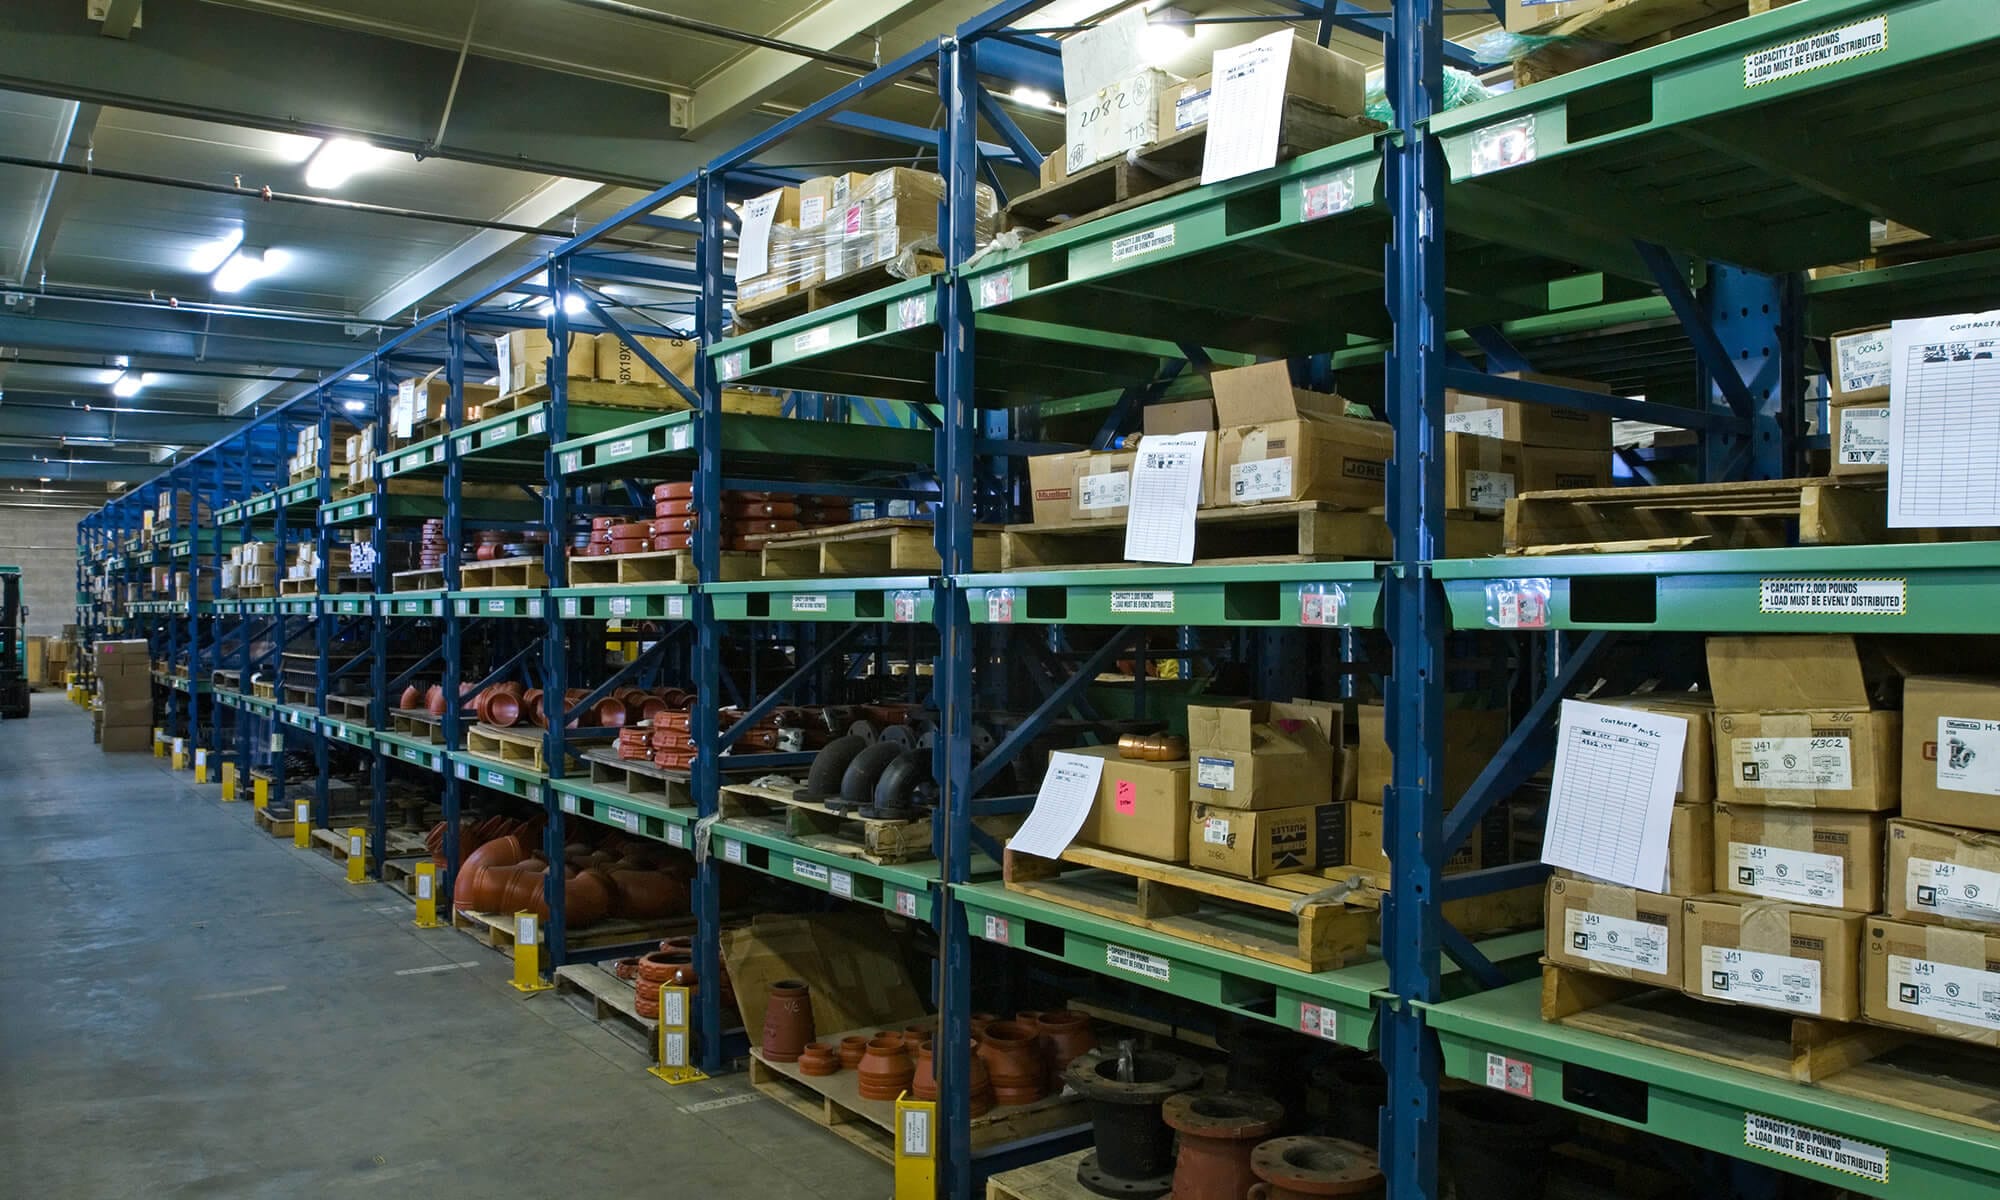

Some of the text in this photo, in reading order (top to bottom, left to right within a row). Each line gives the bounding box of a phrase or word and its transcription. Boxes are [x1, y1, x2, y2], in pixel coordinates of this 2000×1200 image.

[1754, 48, 1788, 66] CAPACITY
[1811, 32, 1840, 48] POUNDS
[1754, 33, 1882, 78] LOAD MUST BE EVENLY DISTRIBUTED
[1081, 92, 1130, 128] 2082
[1346, 463, 1384, 478] JONE
[1770, 583, 1804, 594] CAPACITY
[1828, 583, 1858, 594] POUNDS
[1770, 596, 1900, 608] LOAD MUST BE EVENLY DISTRIBUTED
[1754, 740, 1771, 750] J41
[1810, 738, 1844, 750] 4302
[1760, 761, 1768, 769] 20
[1750, 848, 1767, 857] J41
[1756, 868, 1764, 876] 20
[1936, 864, 1956, 873] J41
[1938, 888, 1948, 896] 20
[1585, 914, 1600, 924] J41
[1725, 952, 1742, 961] J41
[1915, 962, 1935, 974] J41
[1730, 973, 1740, 981] 20
[1920, 986, 1931, 994] 20
[1755, 1118, 1788, 1136] CAPACITY
[1812, 1133, 1842, 1150] POUNDS
[1755, 1130, 1883, 1174] LOAD MUST BE EVENLY DISTRIBUTED
